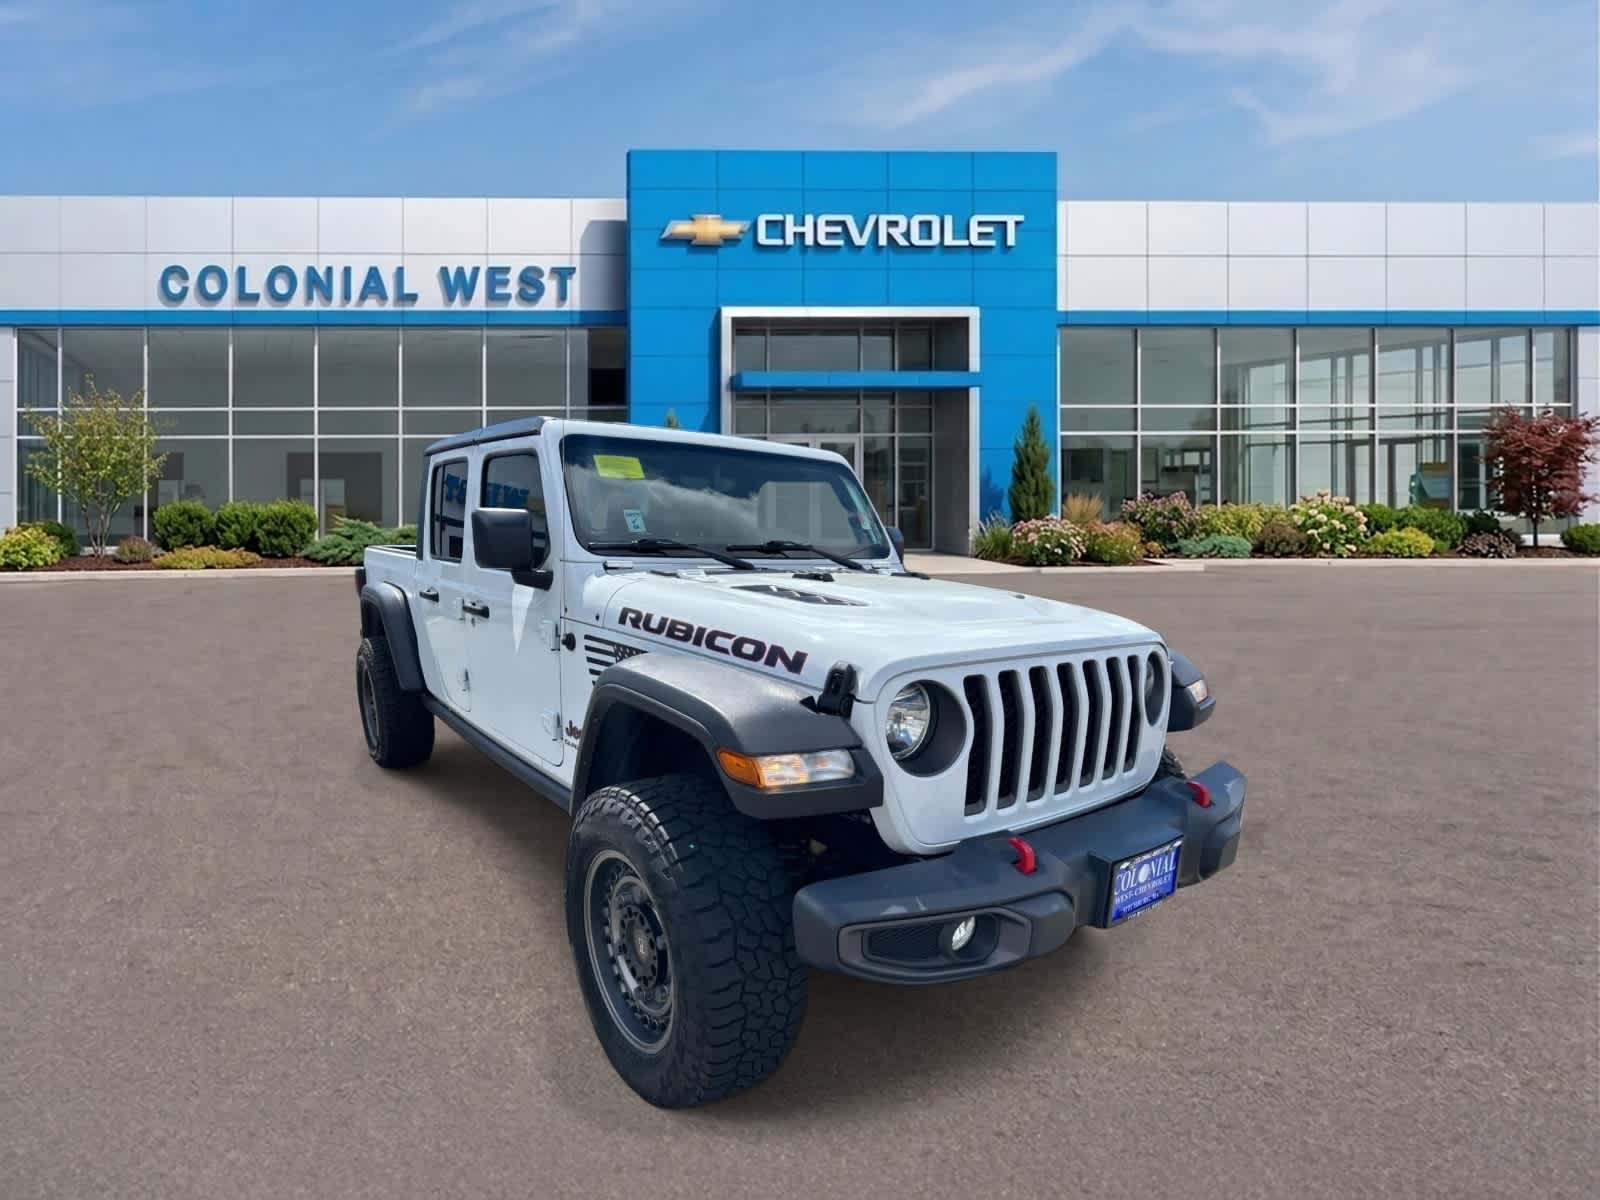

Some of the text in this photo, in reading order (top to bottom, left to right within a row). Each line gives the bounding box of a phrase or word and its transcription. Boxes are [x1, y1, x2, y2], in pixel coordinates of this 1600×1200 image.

[756, 213, 1025, 248] CHEVROLET
[160, 264, 577, 303] COLONIAL WEST
[618, 606, 809, 676] RUBICON
